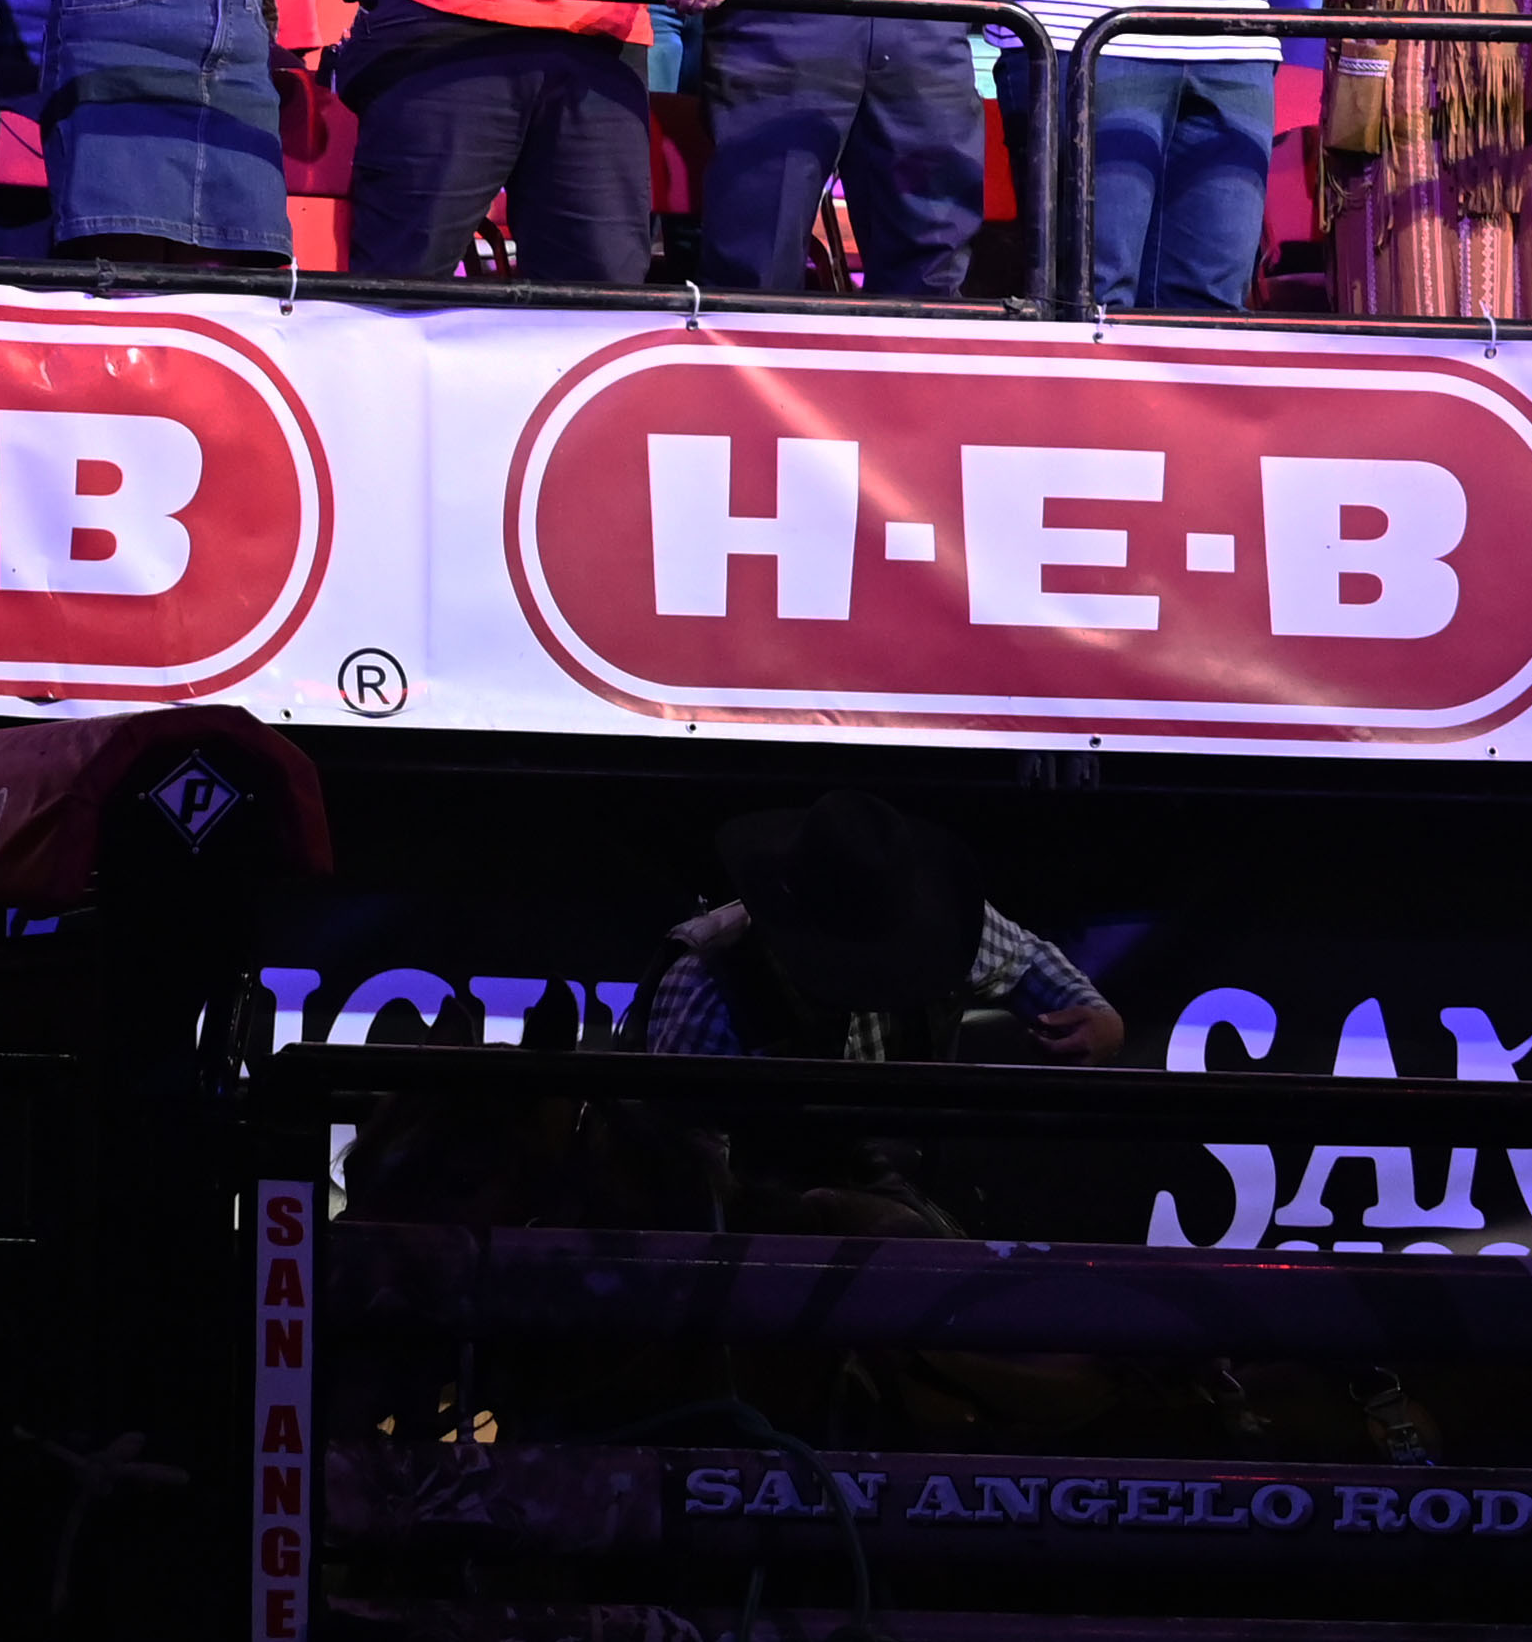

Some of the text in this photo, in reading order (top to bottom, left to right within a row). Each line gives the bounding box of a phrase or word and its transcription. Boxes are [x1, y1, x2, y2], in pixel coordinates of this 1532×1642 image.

[264, 1196, 305, 1368] SAN
[684, 1467, 888, 1523] SAN
[905, 1473, 1317, 1535] ANGELO
